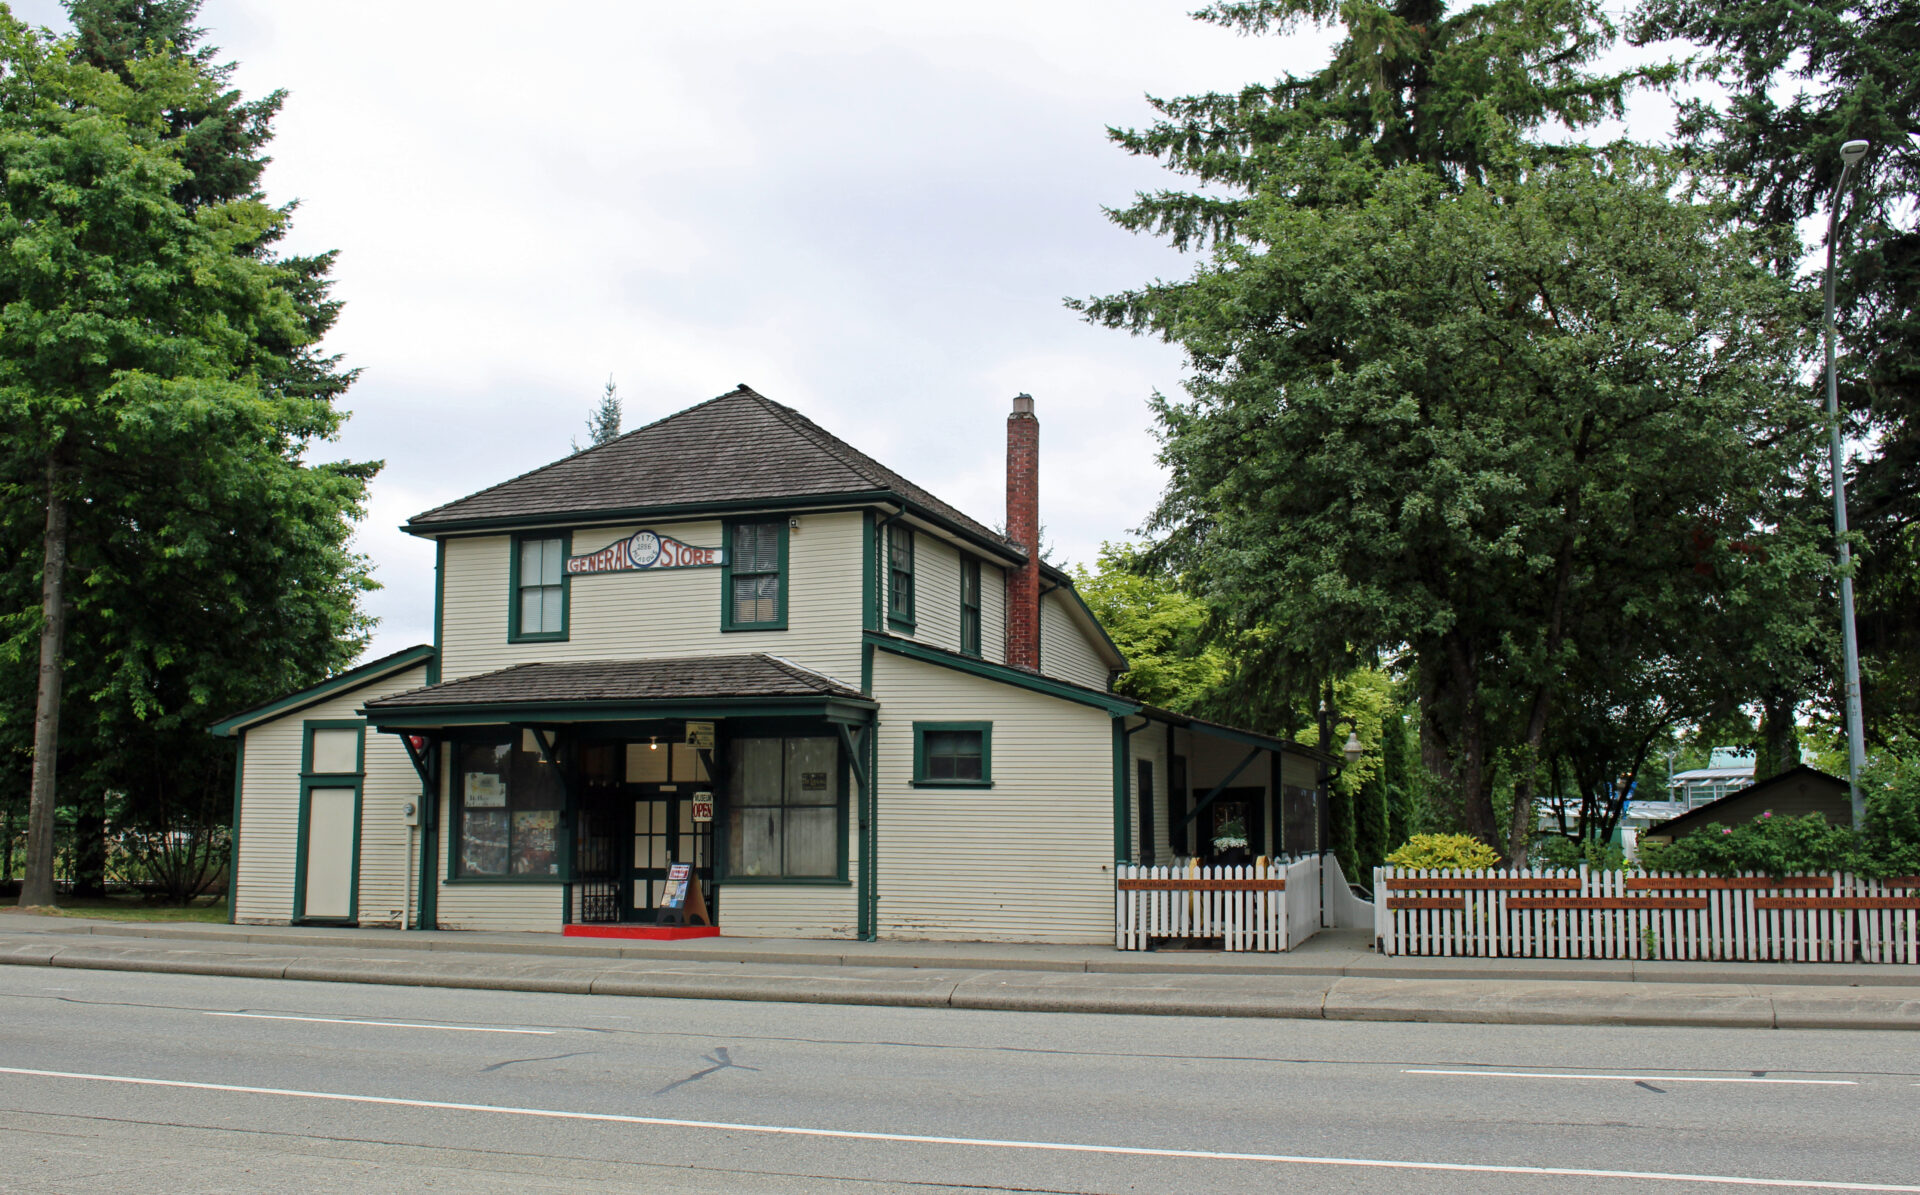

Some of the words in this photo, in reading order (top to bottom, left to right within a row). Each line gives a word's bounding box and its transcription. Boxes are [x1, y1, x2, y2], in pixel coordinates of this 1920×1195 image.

[636, 534, 656, 542] PITT
[569, 540, 632, 572] GENERAL
[661, 539, 714, 566] STORE
[632, 550, 657, 563] MEADOWS
[694, 794, 712, 802] MUSEUM
[692, 803, 713, 817] OPEN
